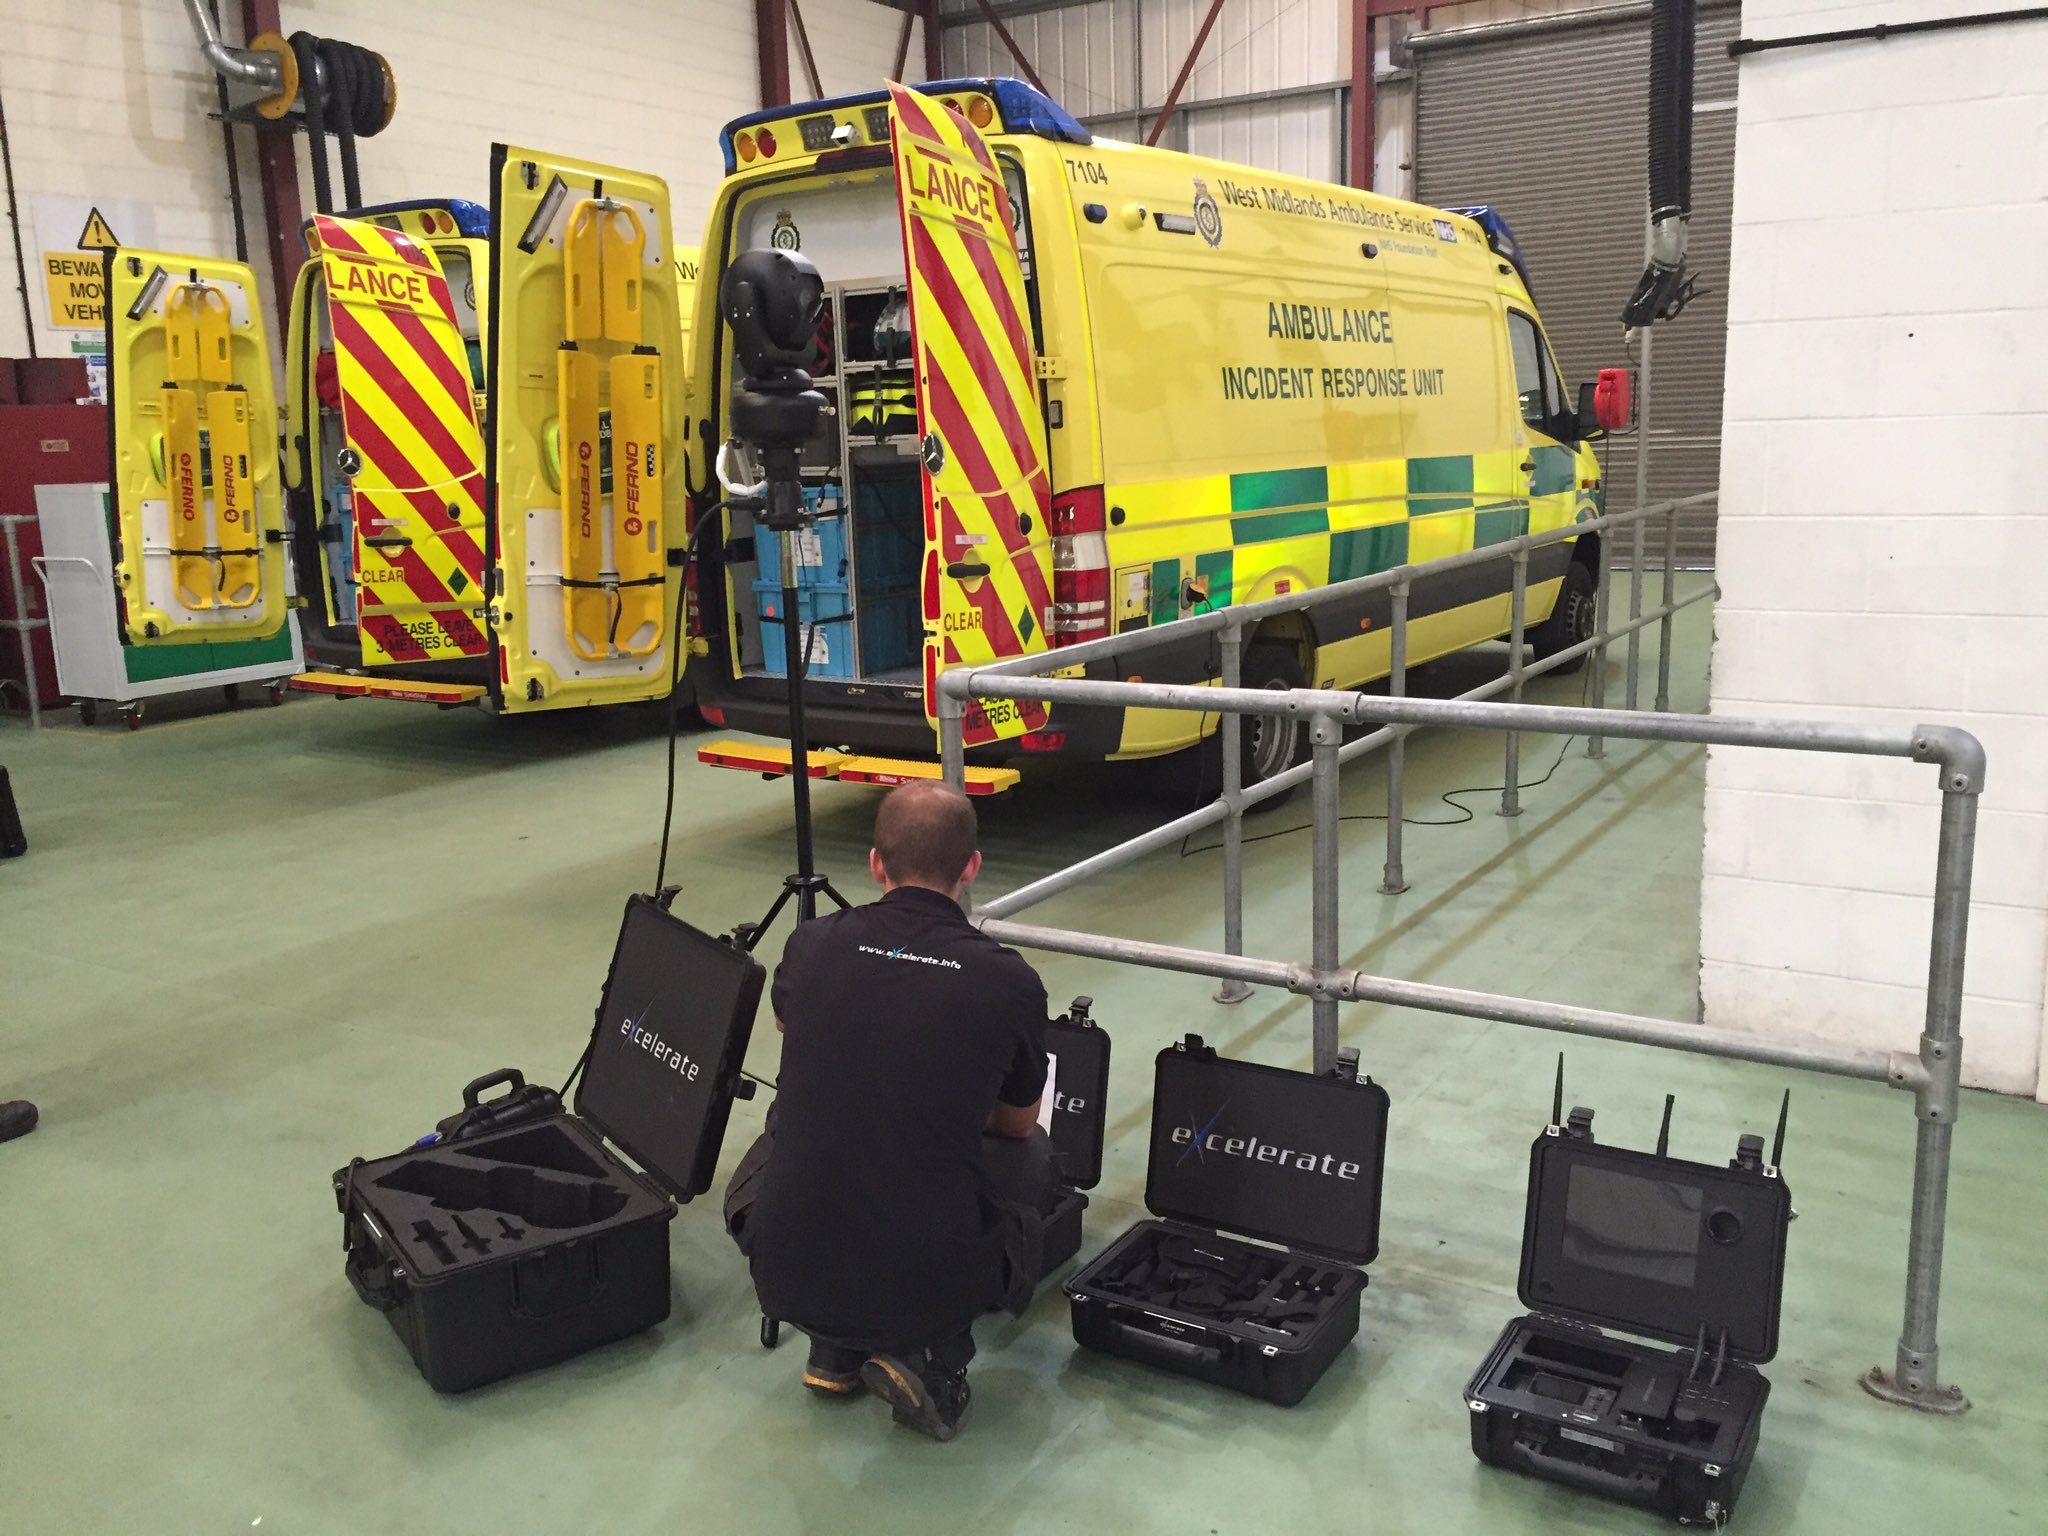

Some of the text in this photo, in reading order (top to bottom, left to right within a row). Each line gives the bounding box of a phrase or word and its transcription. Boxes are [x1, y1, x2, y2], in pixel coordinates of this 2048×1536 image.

[905, 155, 993, 223] LANCE
[1066, 159, 1109, 185] 7104
[1218, 179, 1262, 209] West
[1262, 187, 1327, 218] Midlands
[1328, 199, 1395, 231] Ambulance
[1395, 211, 1435, 237] Service
[48, 259, 105, 278] BEWA
[325, 262, 424, 303] LANCE
[1268, 302, 1393, 344] AMBULANCE
[1222, 366, 1445, 400] INCIDENT RESPONSE UNIT
[181, 466, 195, 521] FERNO
[223, 455, 236, 507] FERNO
[625, 441, 639, 515] FERNO
[580, 464, 591, 538] FERNO
[362, 570, 404, 583] CLEAR
[384, 622, 434, 637] PLEASE
[944, 611, 982, 632] CLEAR
[388, 636, 440, 651] METRES
[444, 633, 483, 648] CLEAR
[966, 704, 1011, 731] METRES
